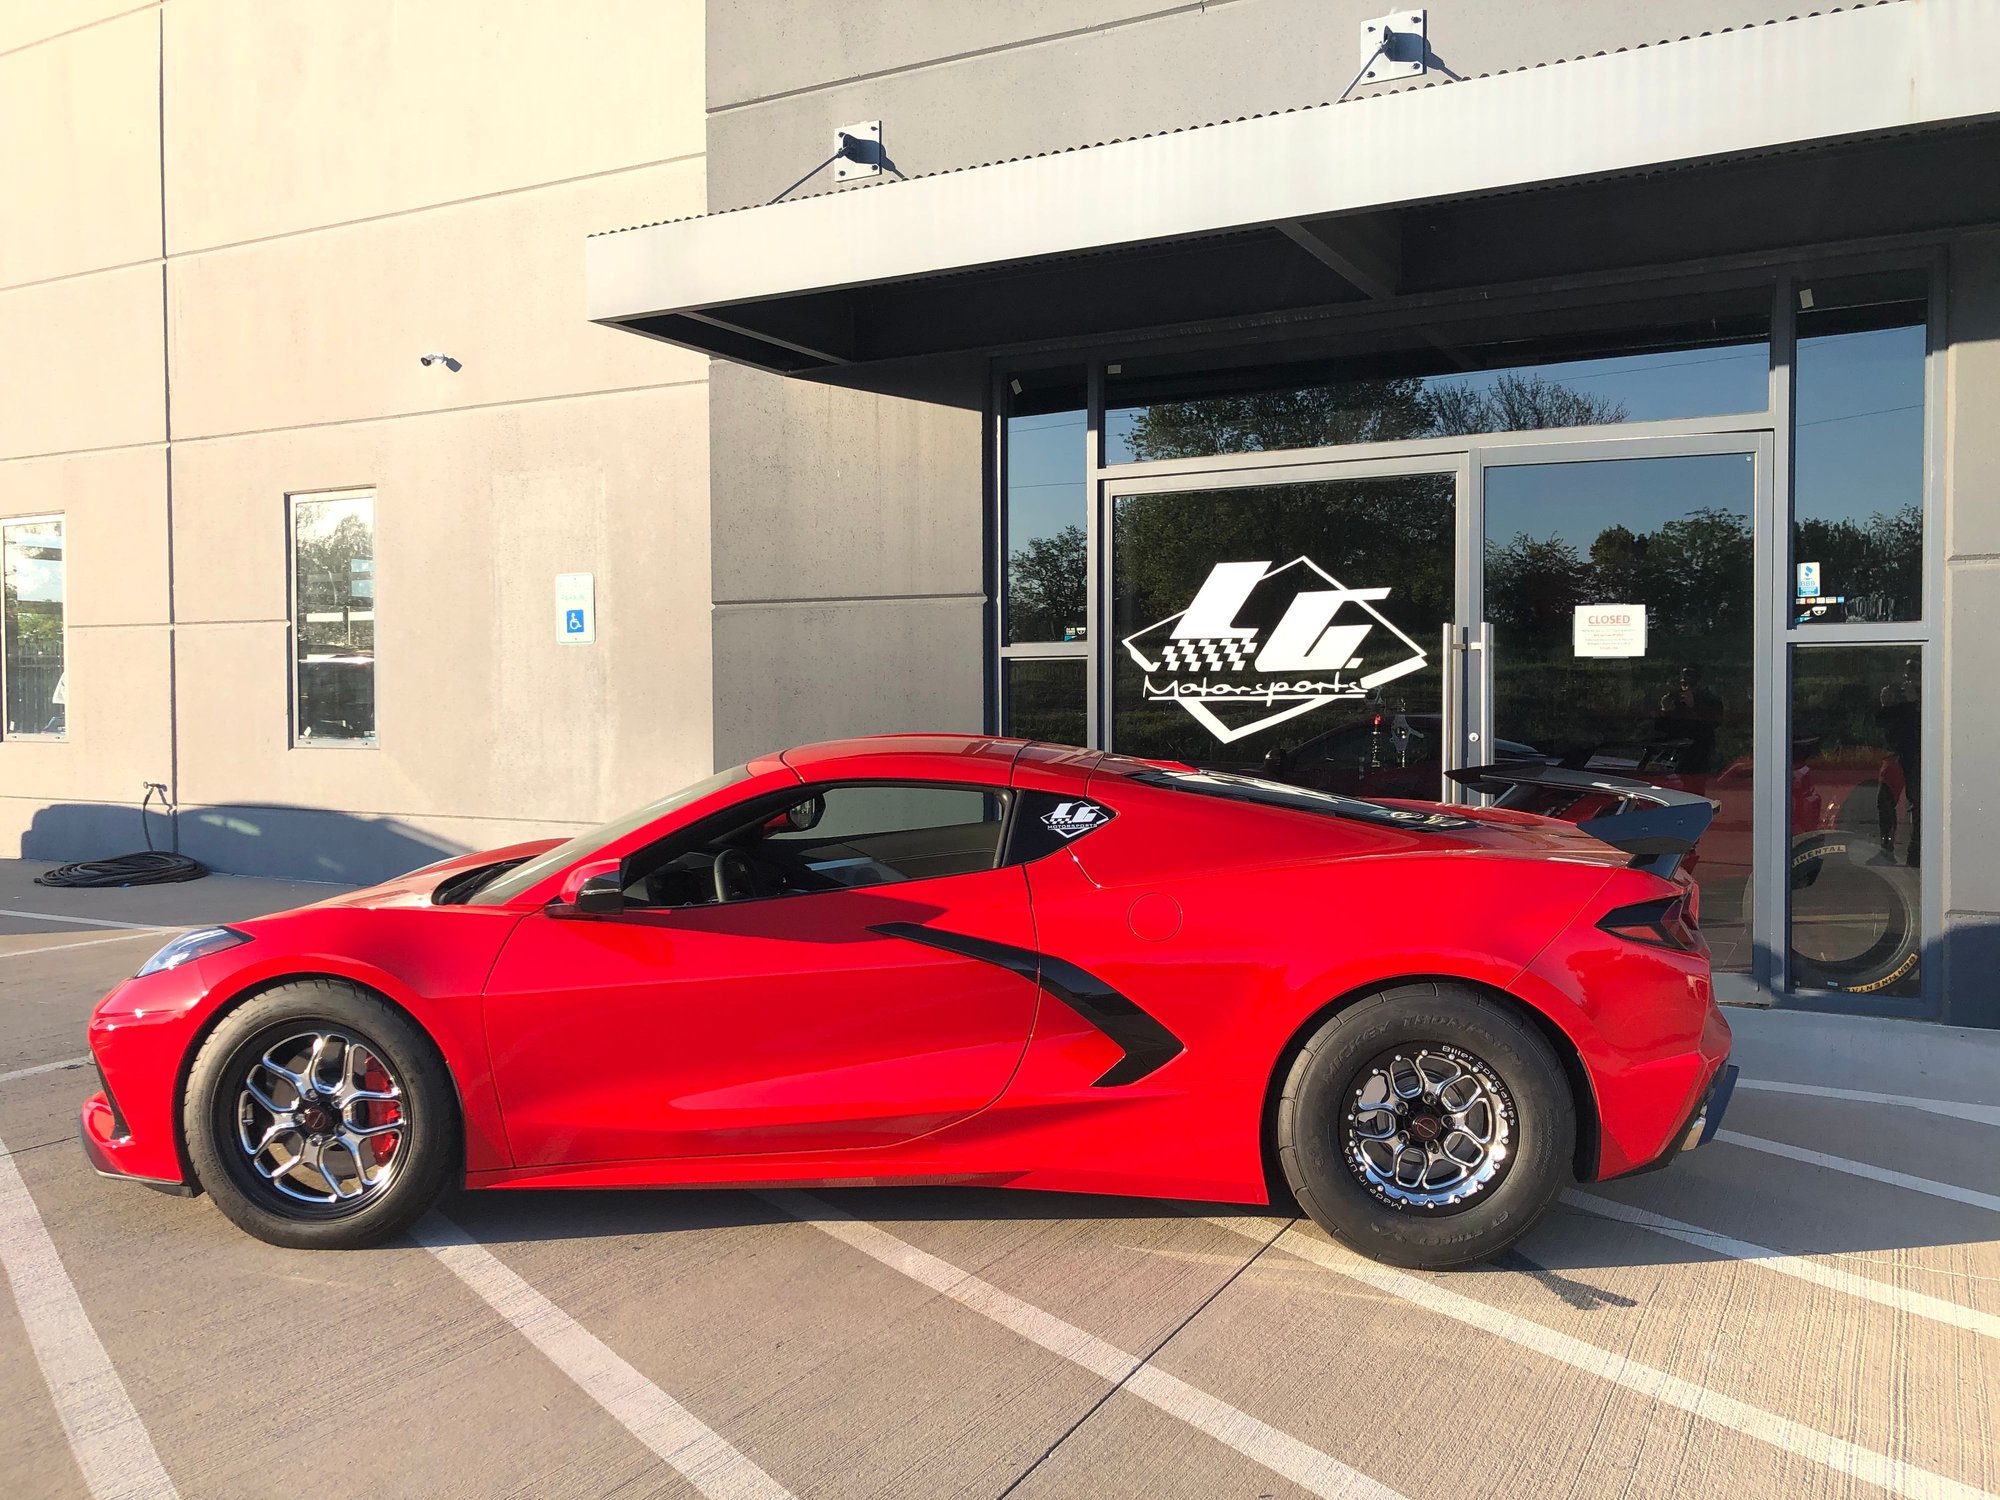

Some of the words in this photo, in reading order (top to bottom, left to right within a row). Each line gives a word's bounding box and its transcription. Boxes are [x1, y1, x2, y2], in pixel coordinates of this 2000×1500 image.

[1588, 615, 1631, 625] CLOSED
[1143, 672, 1369, 707] Motorsports
[1047, 823, 1098, 831] MOTORSPORTS
[1442, 1045, 1474, 1061] Billet
[1476, 1061, 1516, 1126] Specialties
[1344, 1146, 1358, 1173] USA
[1369, 1188, 1402, 1211] Made
